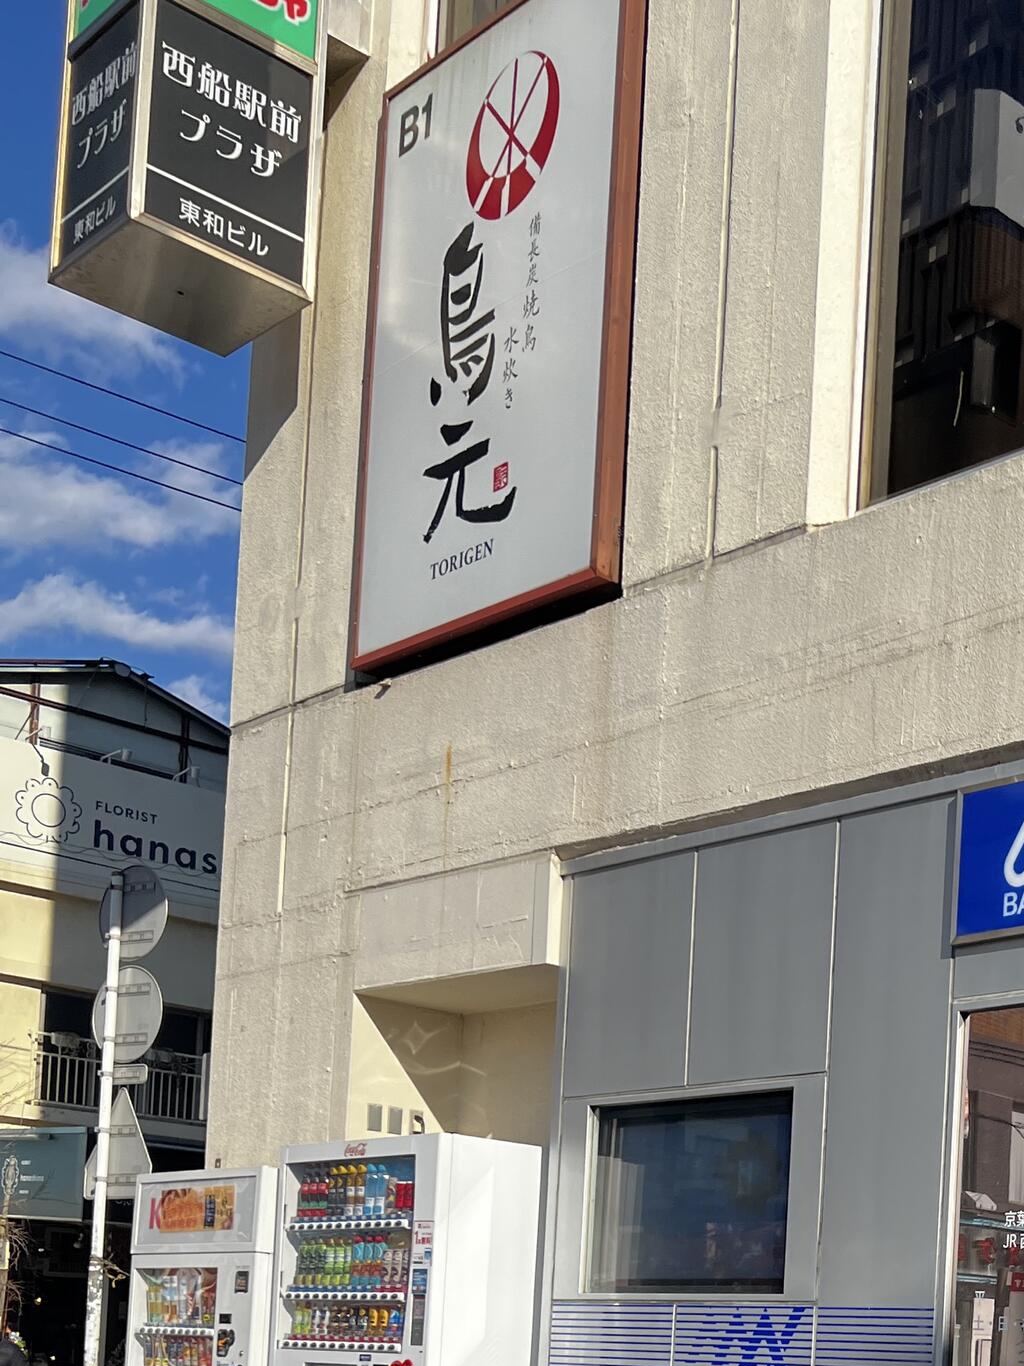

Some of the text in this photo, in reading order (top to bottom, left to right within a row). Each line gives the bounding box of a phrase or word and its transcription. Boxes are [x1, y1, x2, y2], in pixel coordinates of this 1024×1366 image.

[72, 42, 138, 126] 西船駅前
[161, 41, 302, 143] 西船駅前
[77, 98, 127, 169] プラザ
[179, 109, 283, 178] プラザ
[399, 92, 433, 157] B1
[73, 194, 117, 244] 東和ビル
[178, 198, 270, 256] 東和ビル
[421, 220, 518, 544] 鳥元
[430, 538, 494, 581] TORIGEN
[95, 800, 158, 825] FLORIST
[93, 819, 217, 875] hanas
